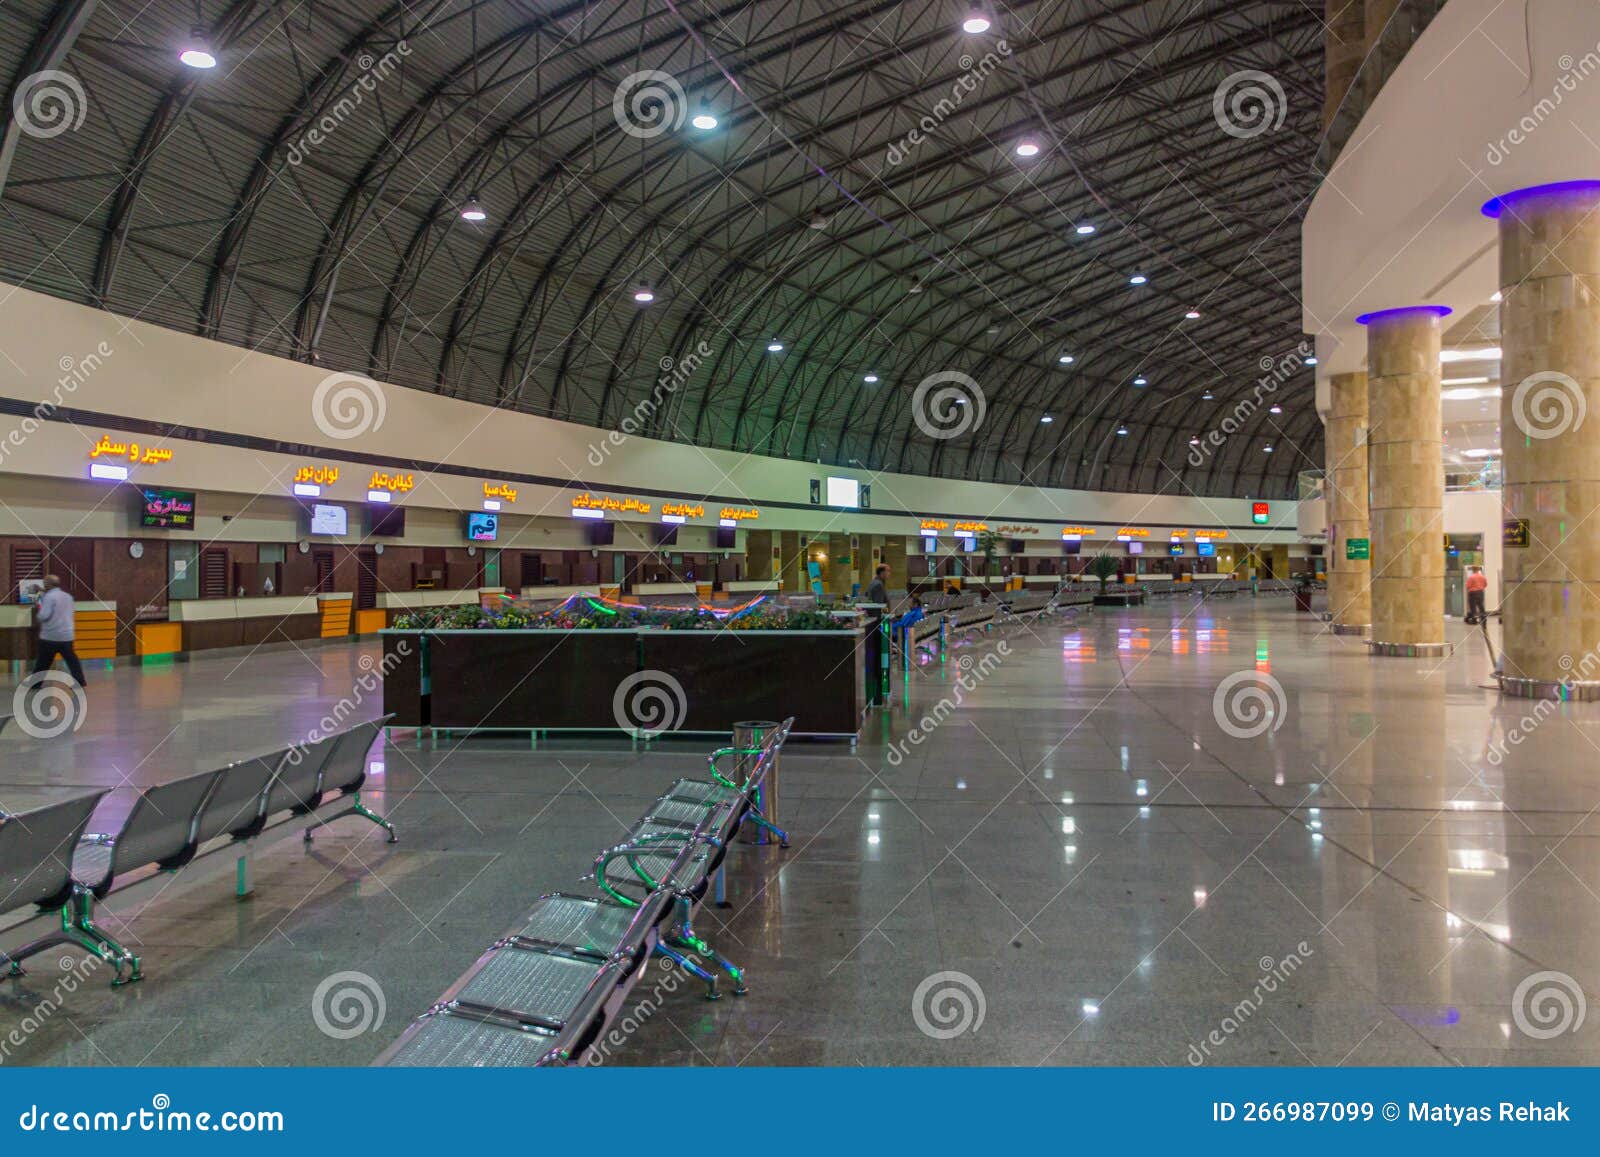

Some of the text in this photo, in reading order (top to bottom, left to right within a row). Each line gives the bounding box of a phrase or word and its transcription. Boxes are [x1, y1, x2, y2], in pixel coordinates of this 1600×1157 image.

[90, 435, 172, 463] سیر و سفر
[472, 515, 495, 537] قم
